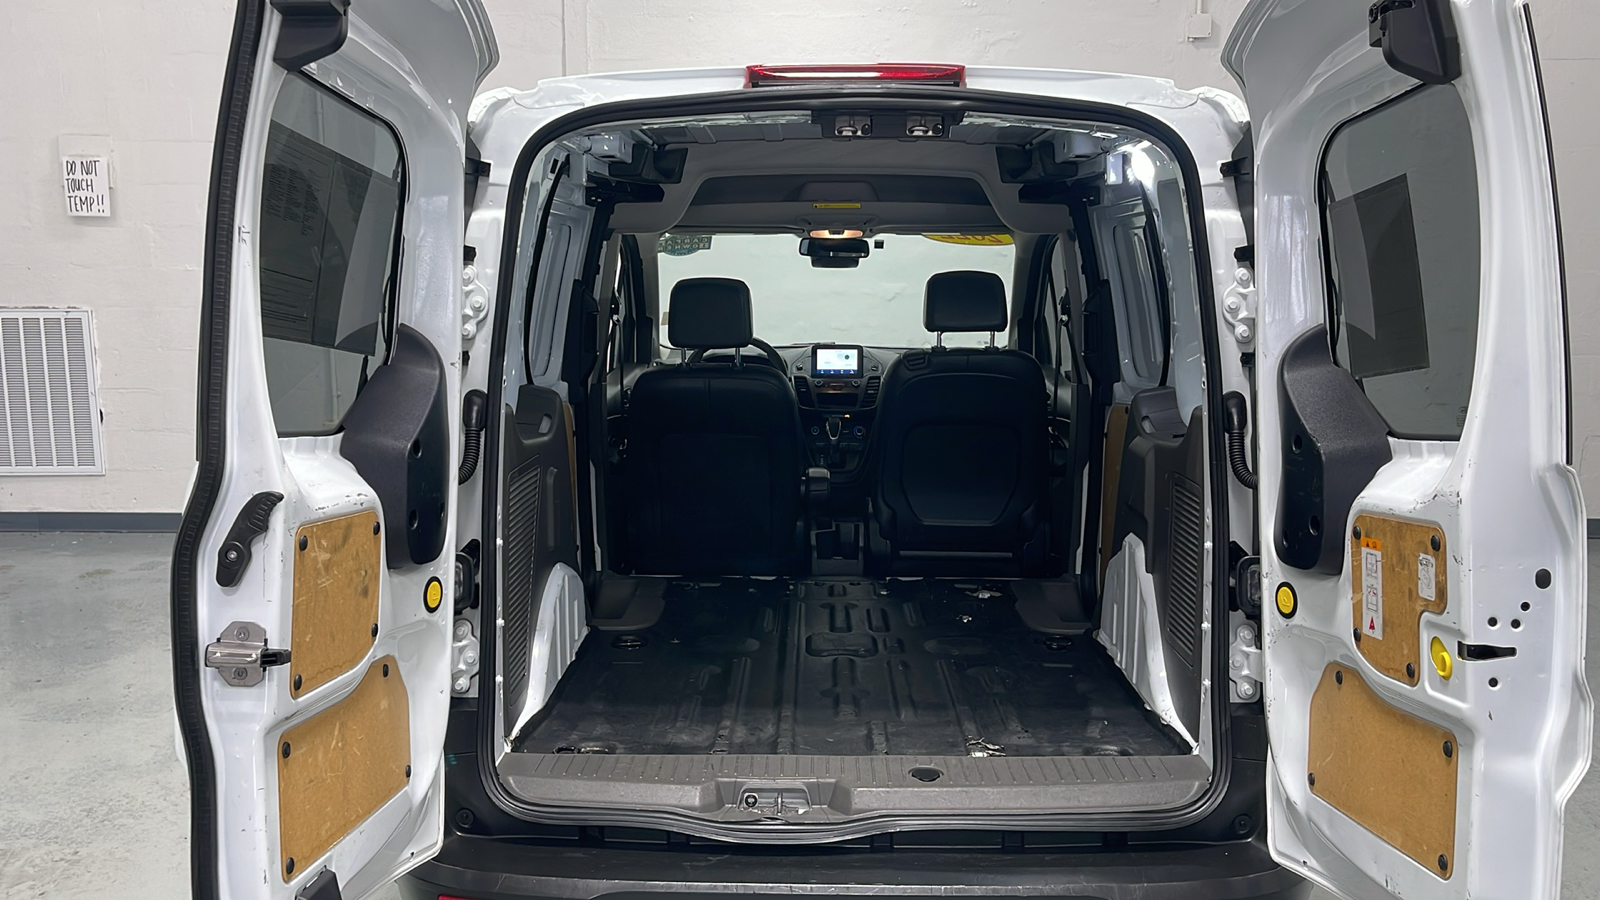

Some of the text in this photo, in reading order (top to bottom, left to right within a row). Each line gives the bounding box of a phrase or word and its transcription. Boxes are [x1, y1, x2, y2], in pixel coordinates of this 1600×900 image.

[66, 160, 100, 176] DO NOT
[65, 178, 94, 193] TOUCH
[67, 194, 105, 213] TEMP!!
